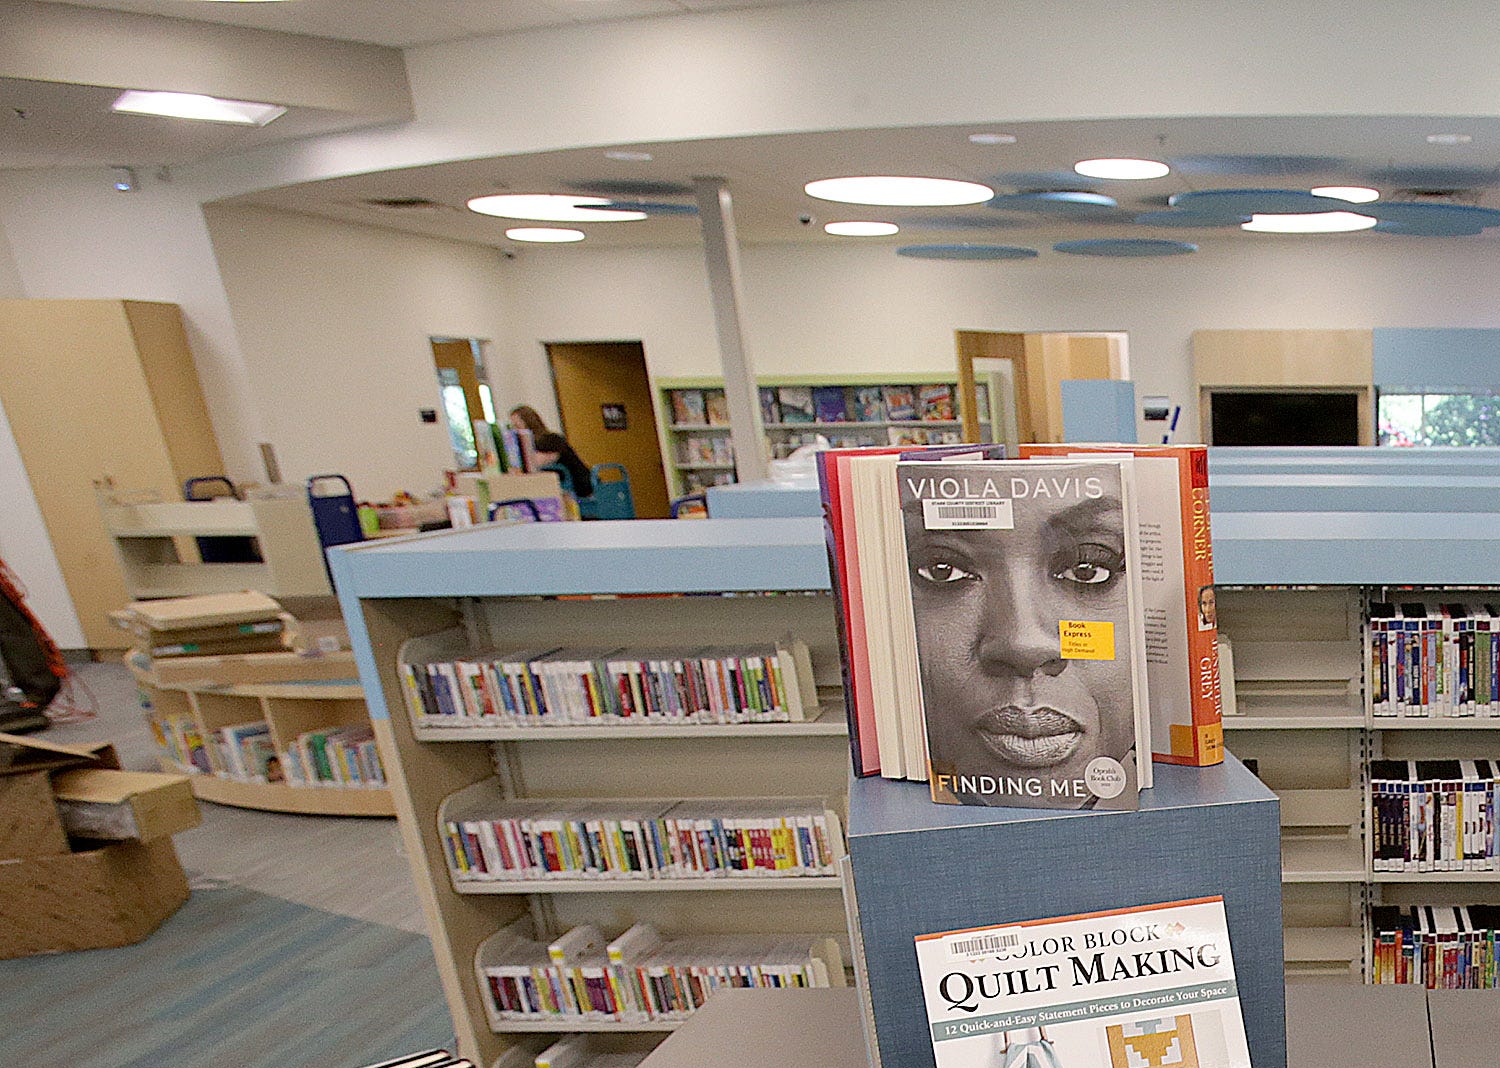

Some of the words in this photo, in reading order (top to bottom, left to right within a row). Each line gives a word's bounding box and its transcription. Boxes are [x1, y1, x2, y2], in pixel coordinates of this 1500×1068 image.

[907, 477, 1000, 499] VIOLA
[1011, 477, 1104, 499] DAVIS
[1191, 487, 1207, 561] CORNER
[1063, 629, 1092, 638] Express
[1068, 621, 1086, 629] Book
[1200, 657, 1214, 700] GREY
[938, 774, 1043, 796] FINDING
[1051, 779, 1087, 797] ME
[1084, 924, 1161, 950] BLOCK
[939, 964, 1060, 1013] QUILT
[1068, 943, 1221, 986] MAKING
[944, 1024, 958, 1036] 12
[959, 1013, 1038, 1035] Quick-and-Easy
[1038, 1005, 1088, 1023] Statement
[1089, 1000, 1119, 1014] Pieces
[1120, 999, 1131, 1009] to
[1132, 993, 1175, 1008] Decorate
[1175, 989, 1199, 1001] Your
[1200, 984, 1227, 999] Space
